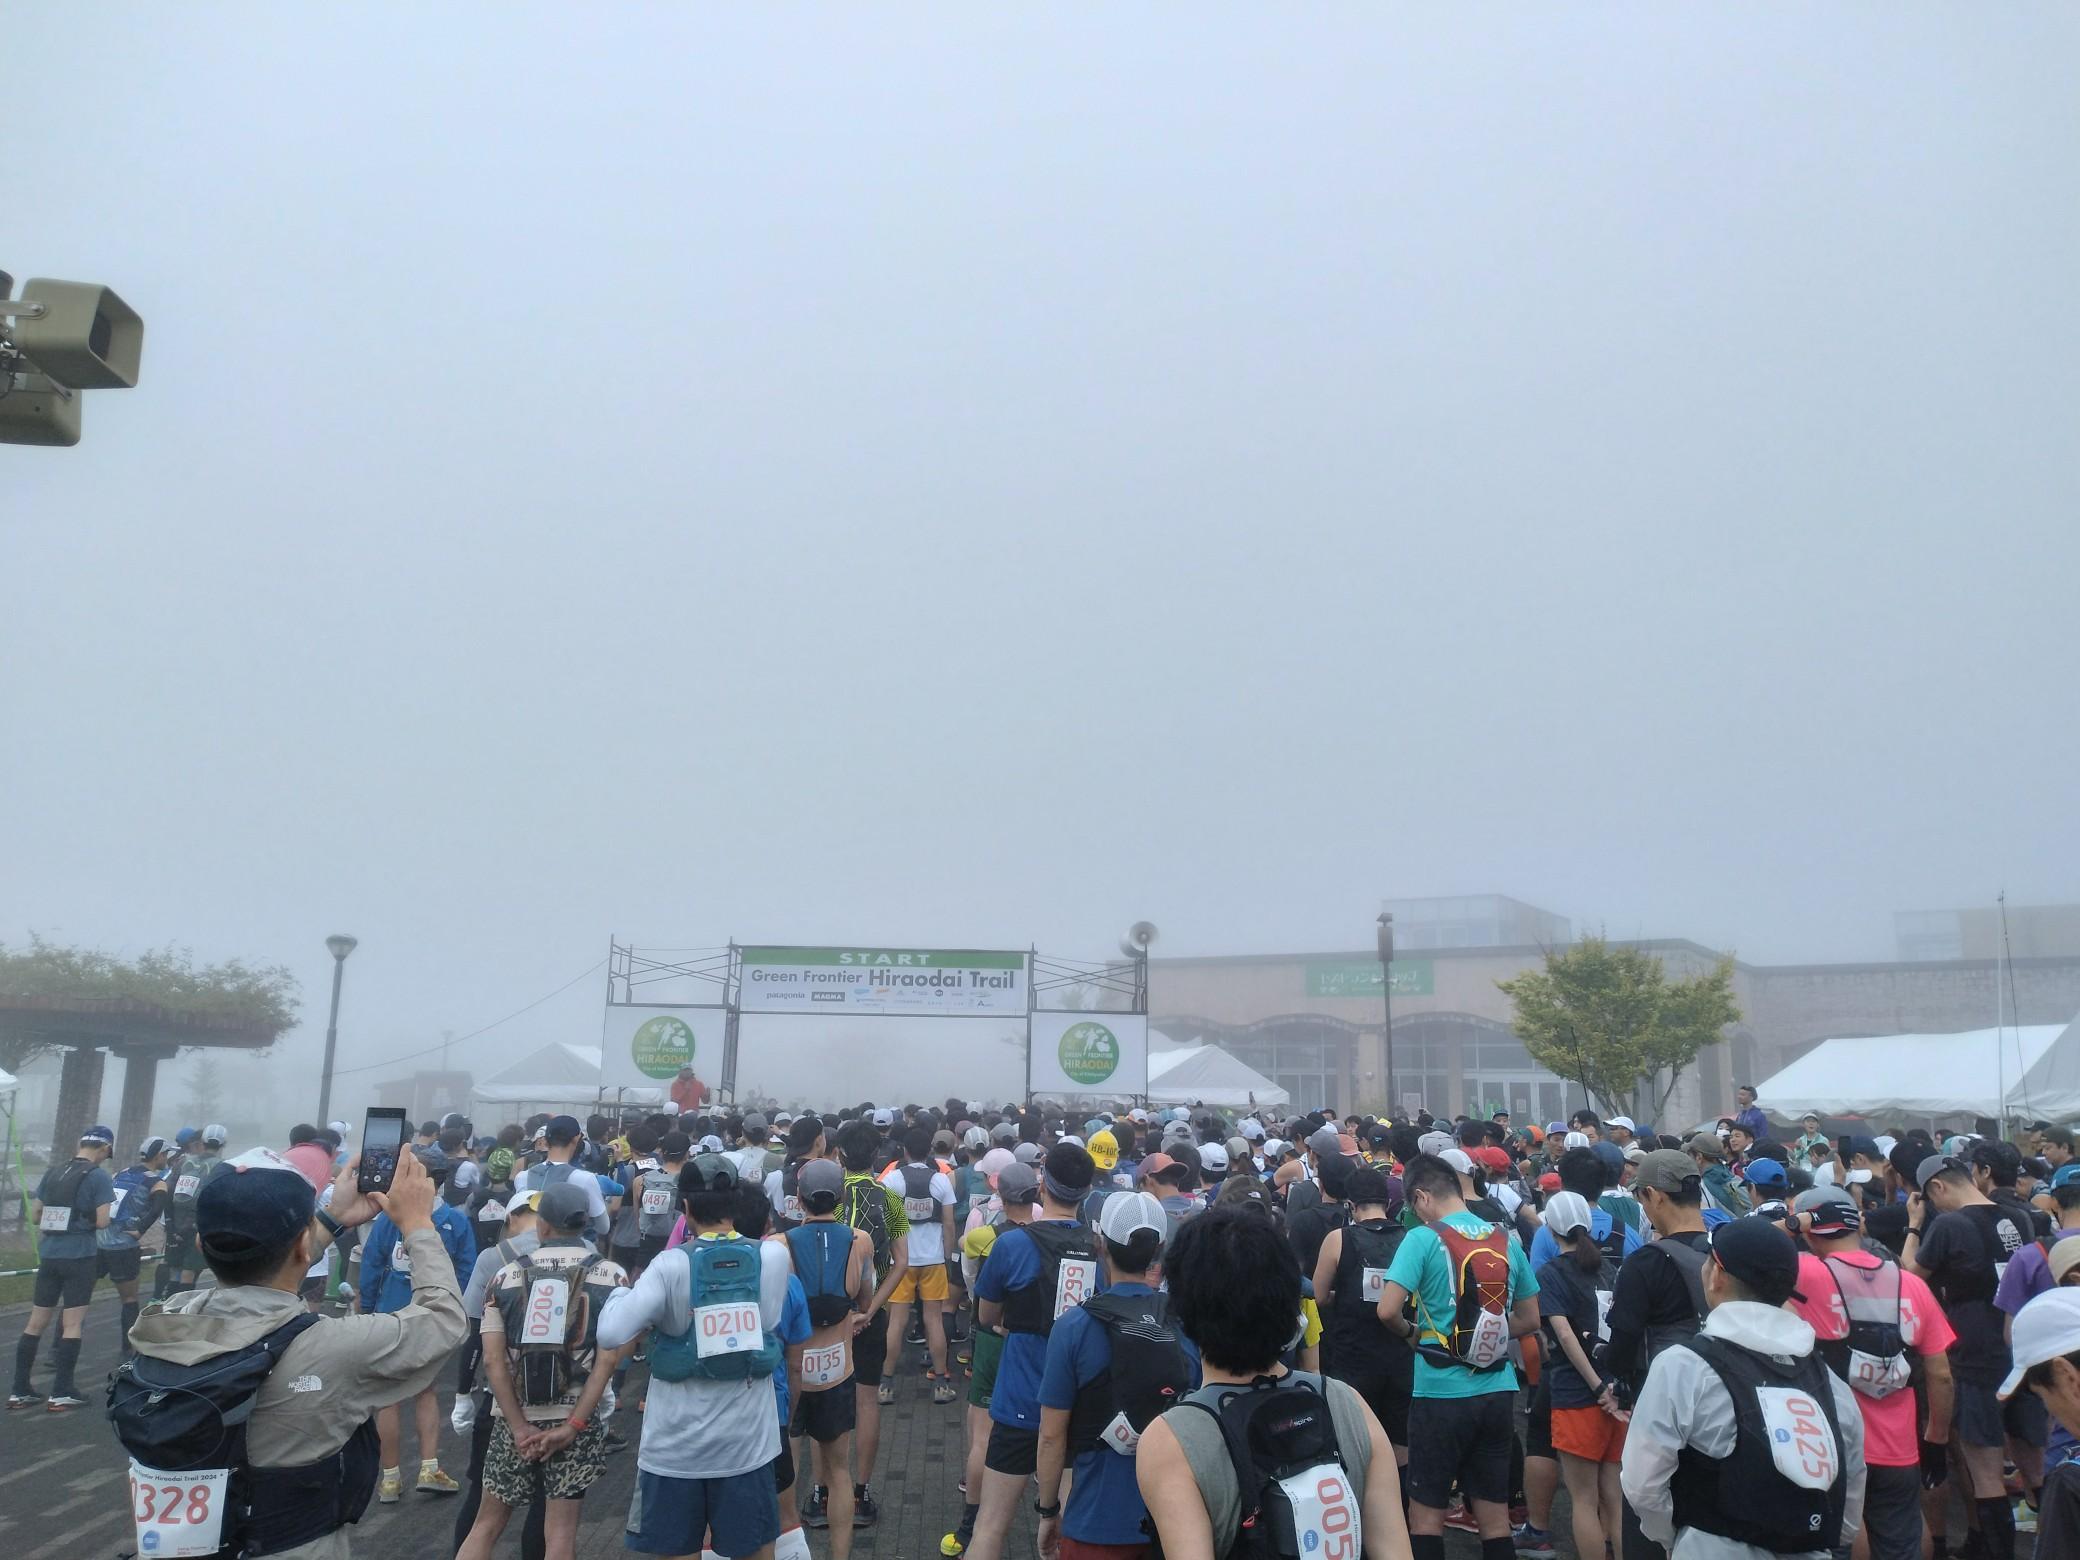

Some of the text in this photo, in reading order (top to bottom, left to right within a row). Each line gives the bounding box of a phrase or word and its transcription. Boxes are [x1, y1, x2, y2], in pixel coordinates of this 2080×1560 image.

[839, 952, 931, 965] START
[751, 968, 1014, 988] Green Frontier Hiraodai Trail
[766, 991, 805, 1000] patagonia
[1063, 1059, 1114, 1070] HIRAODAI
[529, 1284, 555, 1338] 0206
[703, 1310, 757, 1337] 0210
[1475, 1319, 1501, 1364] 0293
[804, 1350, 841, 1373] 0135
[1786, 1397, 1832, 1483] 0425
